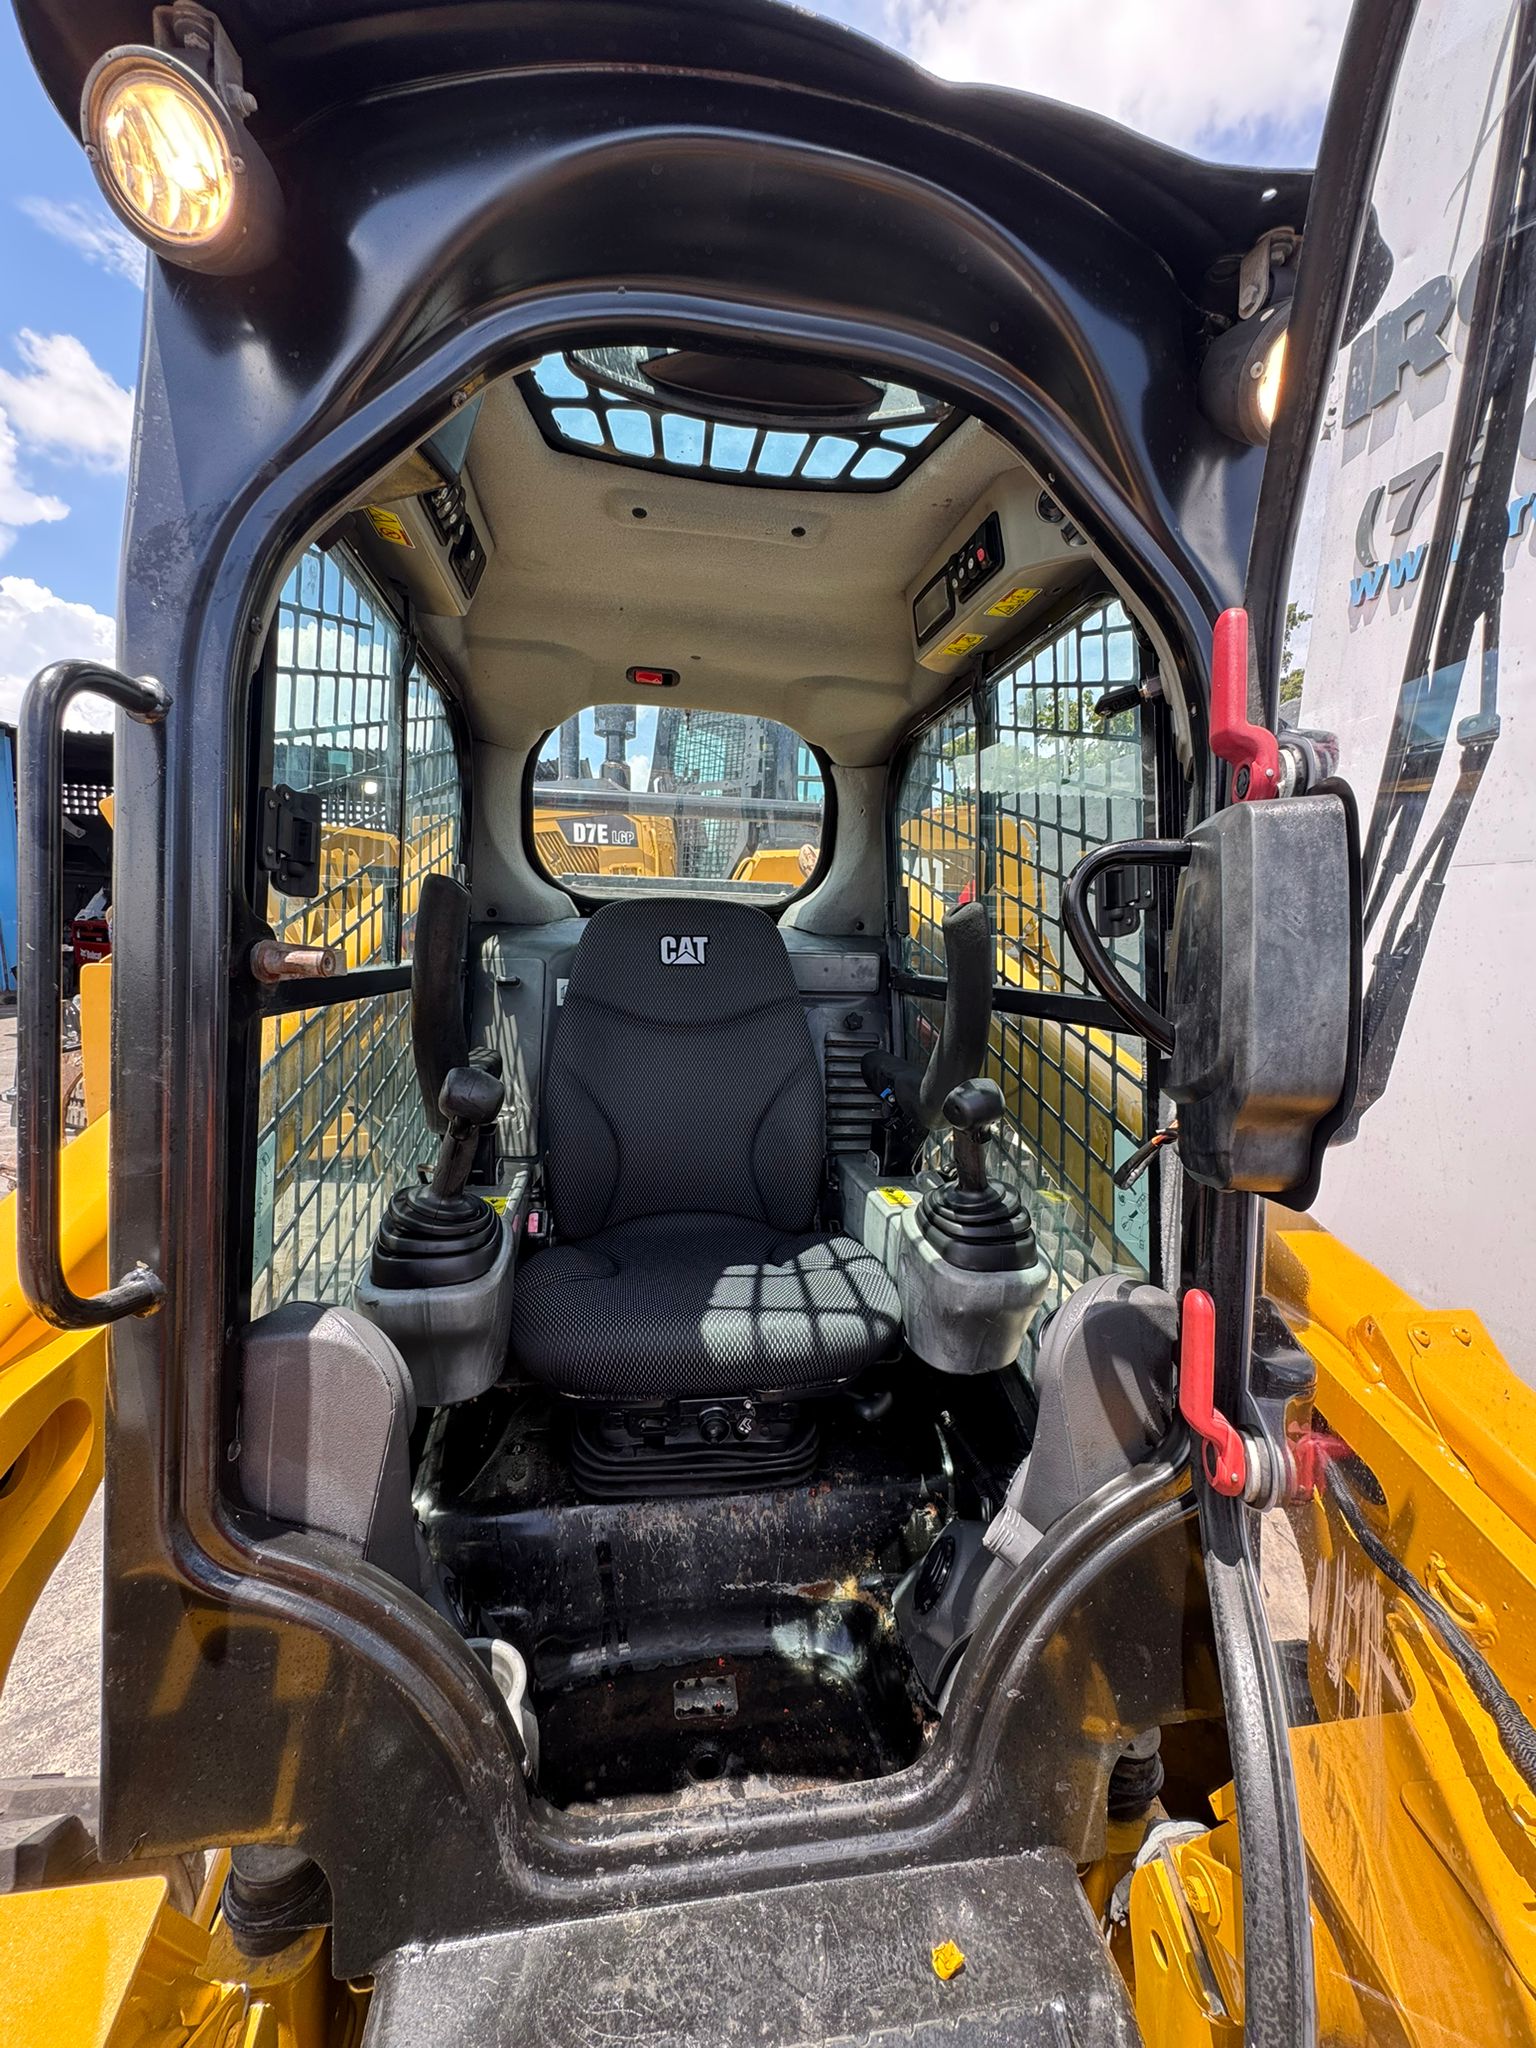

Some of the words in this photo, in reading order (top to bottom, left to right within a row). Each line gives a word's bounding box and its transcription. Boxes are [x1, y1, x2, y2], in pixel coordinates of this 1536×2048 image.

[573, 822, 608, 843] D7E
[612, 830, 634, 844] LGP
[661, 936, 708, 965] CAT
